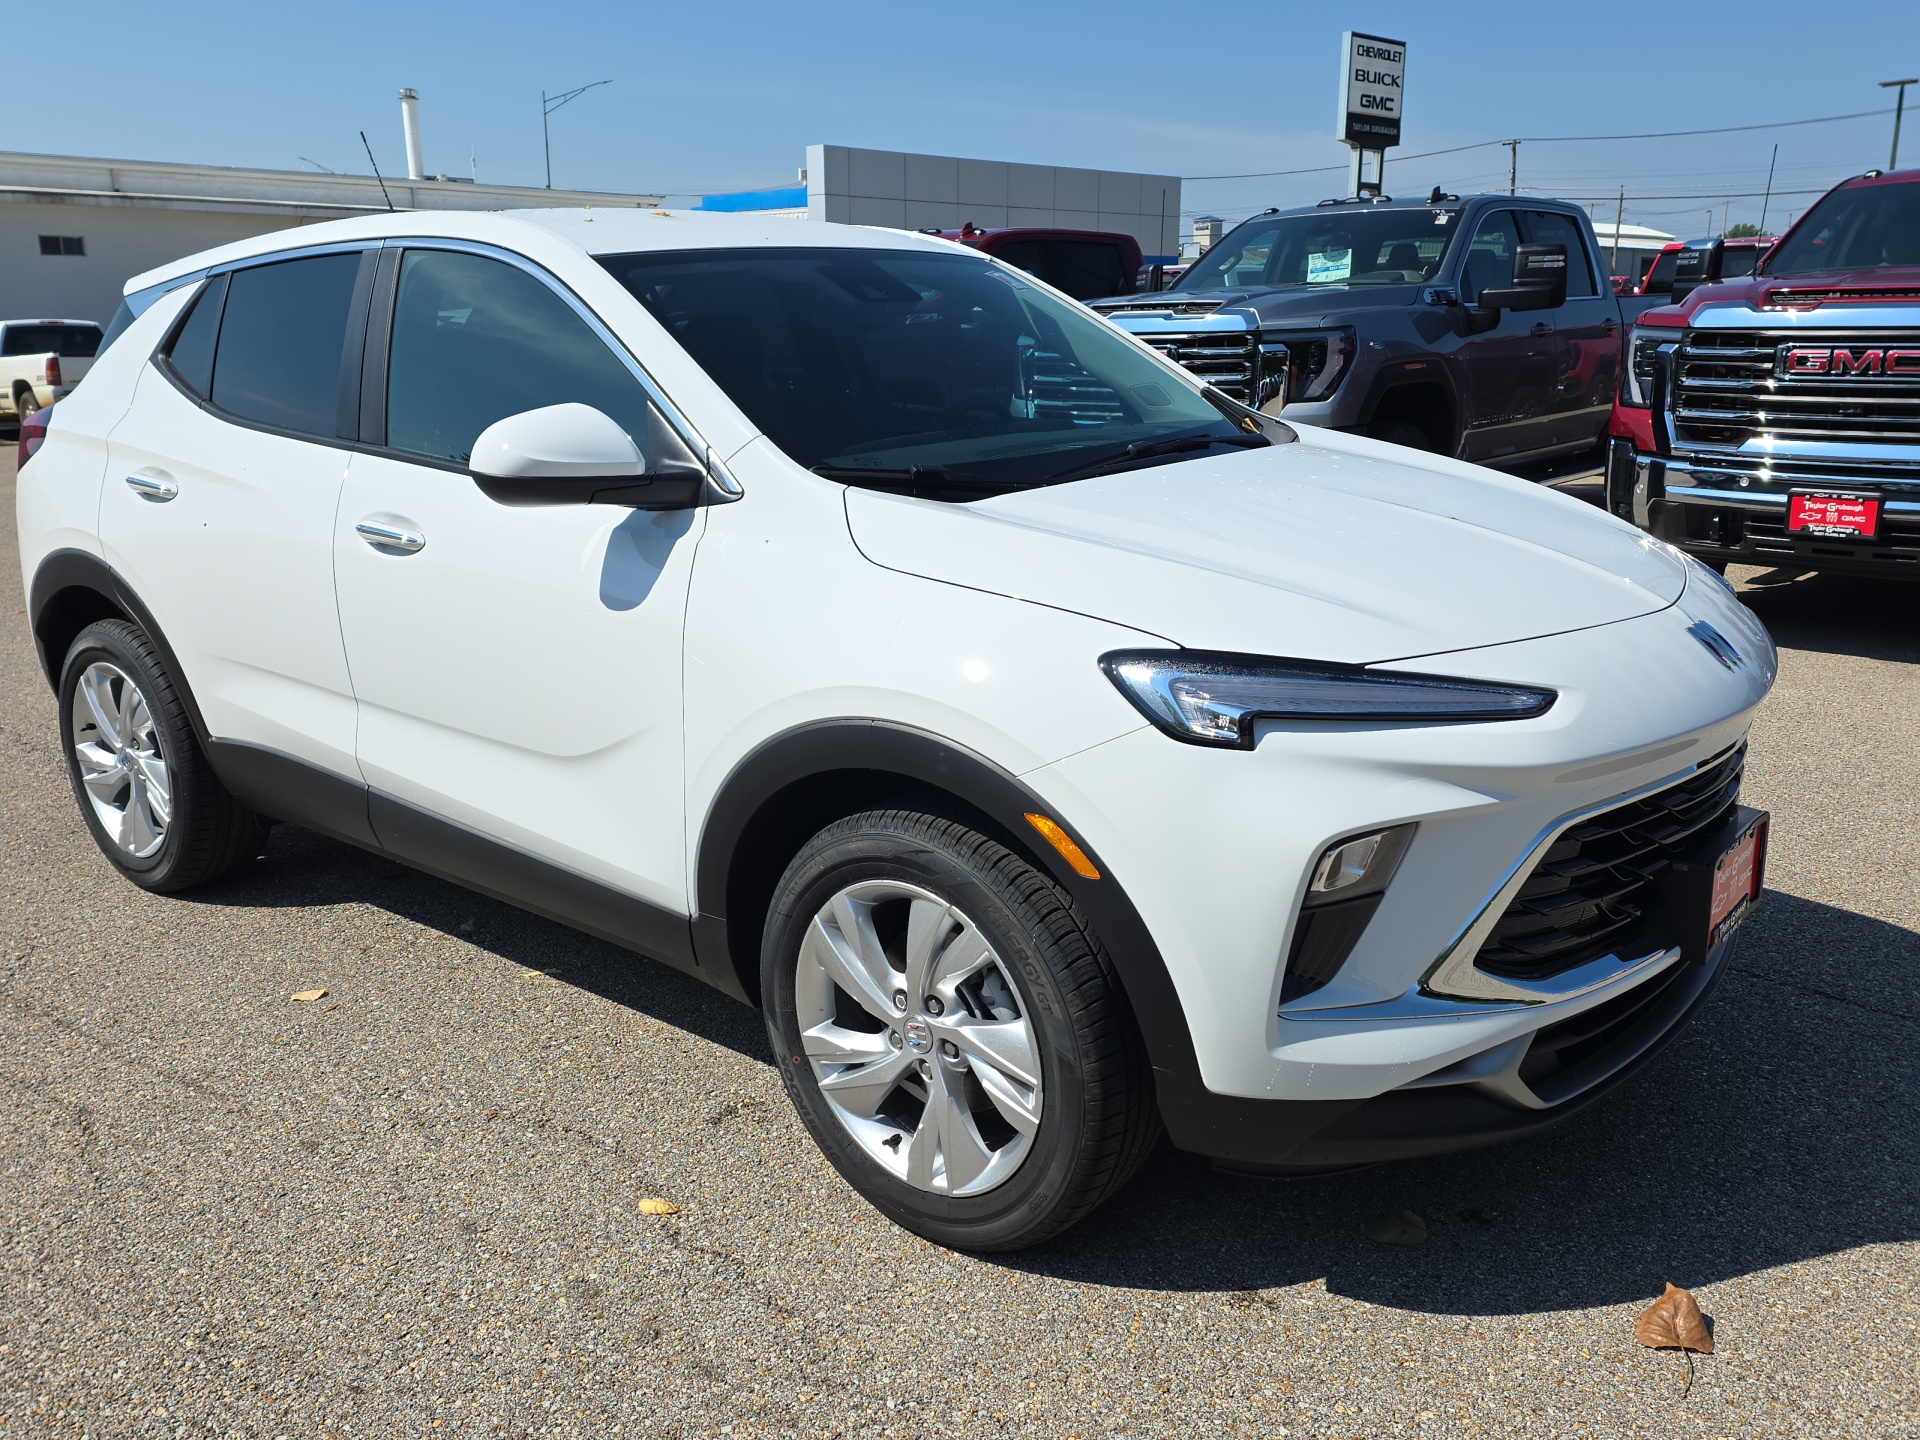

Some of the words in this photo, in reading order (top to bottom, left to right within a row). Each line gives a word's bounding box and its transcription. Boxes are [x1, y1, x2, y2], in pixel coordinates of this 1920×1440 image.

[1357, 44, 1403, 63] CHEVROLET
[1355, 68, 1401, 88] BUICK
[1360, 93, 1395, 112] GMC
[1352, 122, 1370, 132] TAYLOR
[1371, 124, 1398, 136] GRUBAUGH
[1787, 348, 1920, 374] GMC
[1803, 501, 1827, 510] Taylor
[1827, 502, 1864, 512] Grubaugh
[1841, 515, 1866, 523] GMC
[1716, 865, 1732, 891] Taylor
[1732, 843, 1754, 876] Grubaugh
[1738, 864, 1753, 887] GMC
[1719, 918, 1731, 939] Taylor
[1731, 901, 1747, 926] Grubaugh
[1036, 992, 1054, 1015] GT
